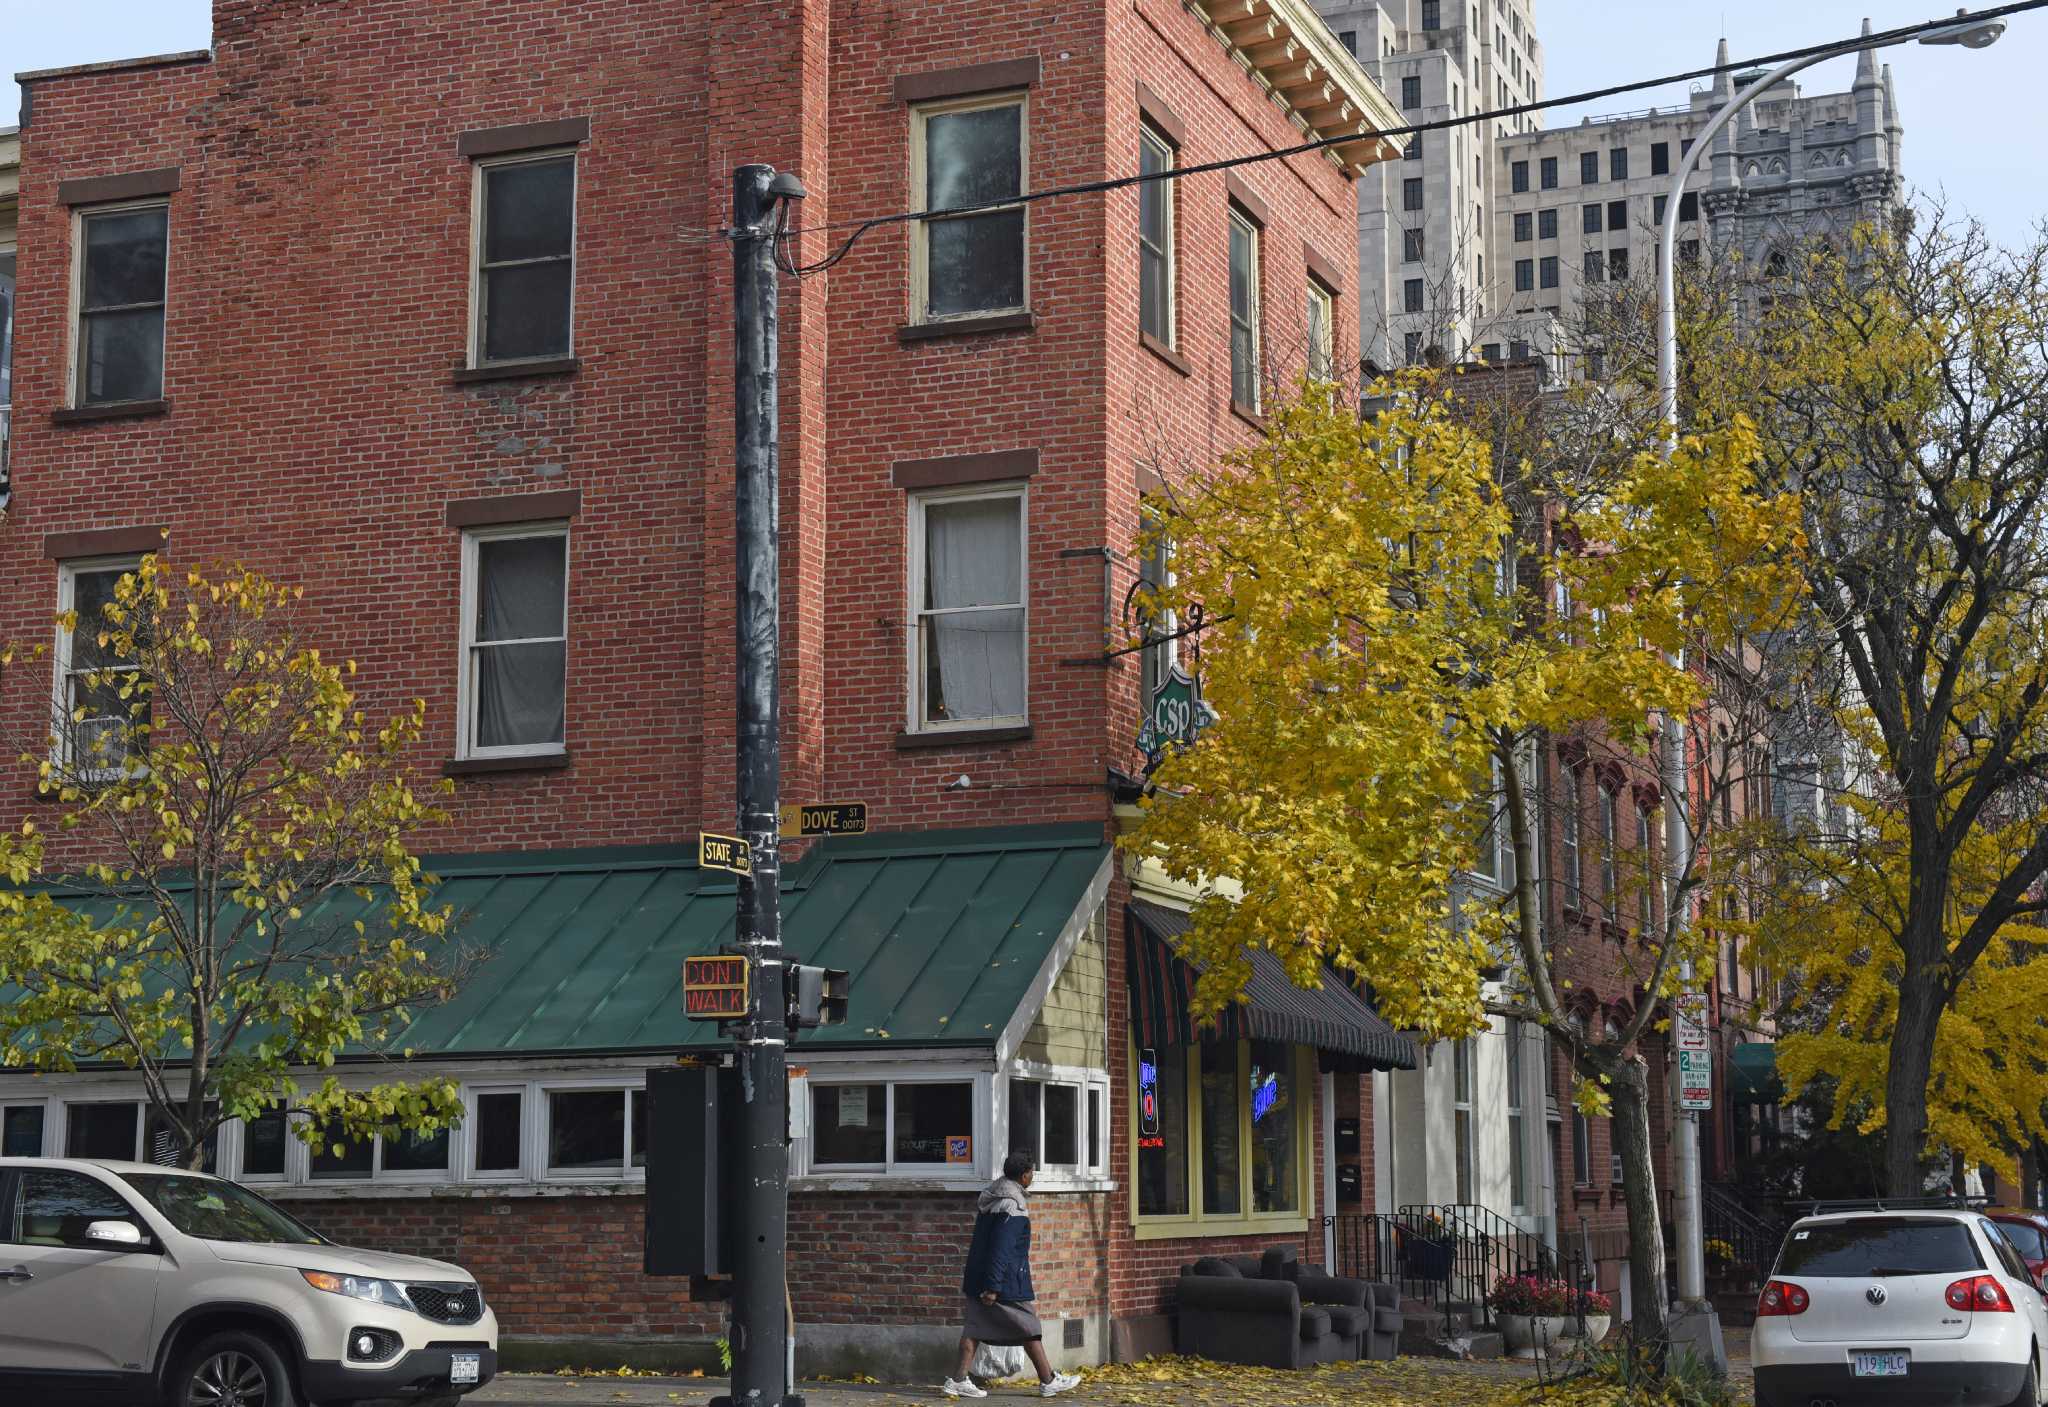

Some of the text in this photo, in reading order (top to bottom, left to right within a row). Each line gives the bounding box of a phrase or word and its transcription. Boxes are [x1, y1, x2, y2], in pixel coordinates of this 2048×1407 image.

[802, 808, 857, 829] DOVE ST
[706, 842, 731, 862] STATE
[687, 960, 741, 984] DONT
[687, 990, 742, 1011] WALK
[1681, 1054, 1689, 1068] 2
[1858, 1357, 1876, 1369] 119
